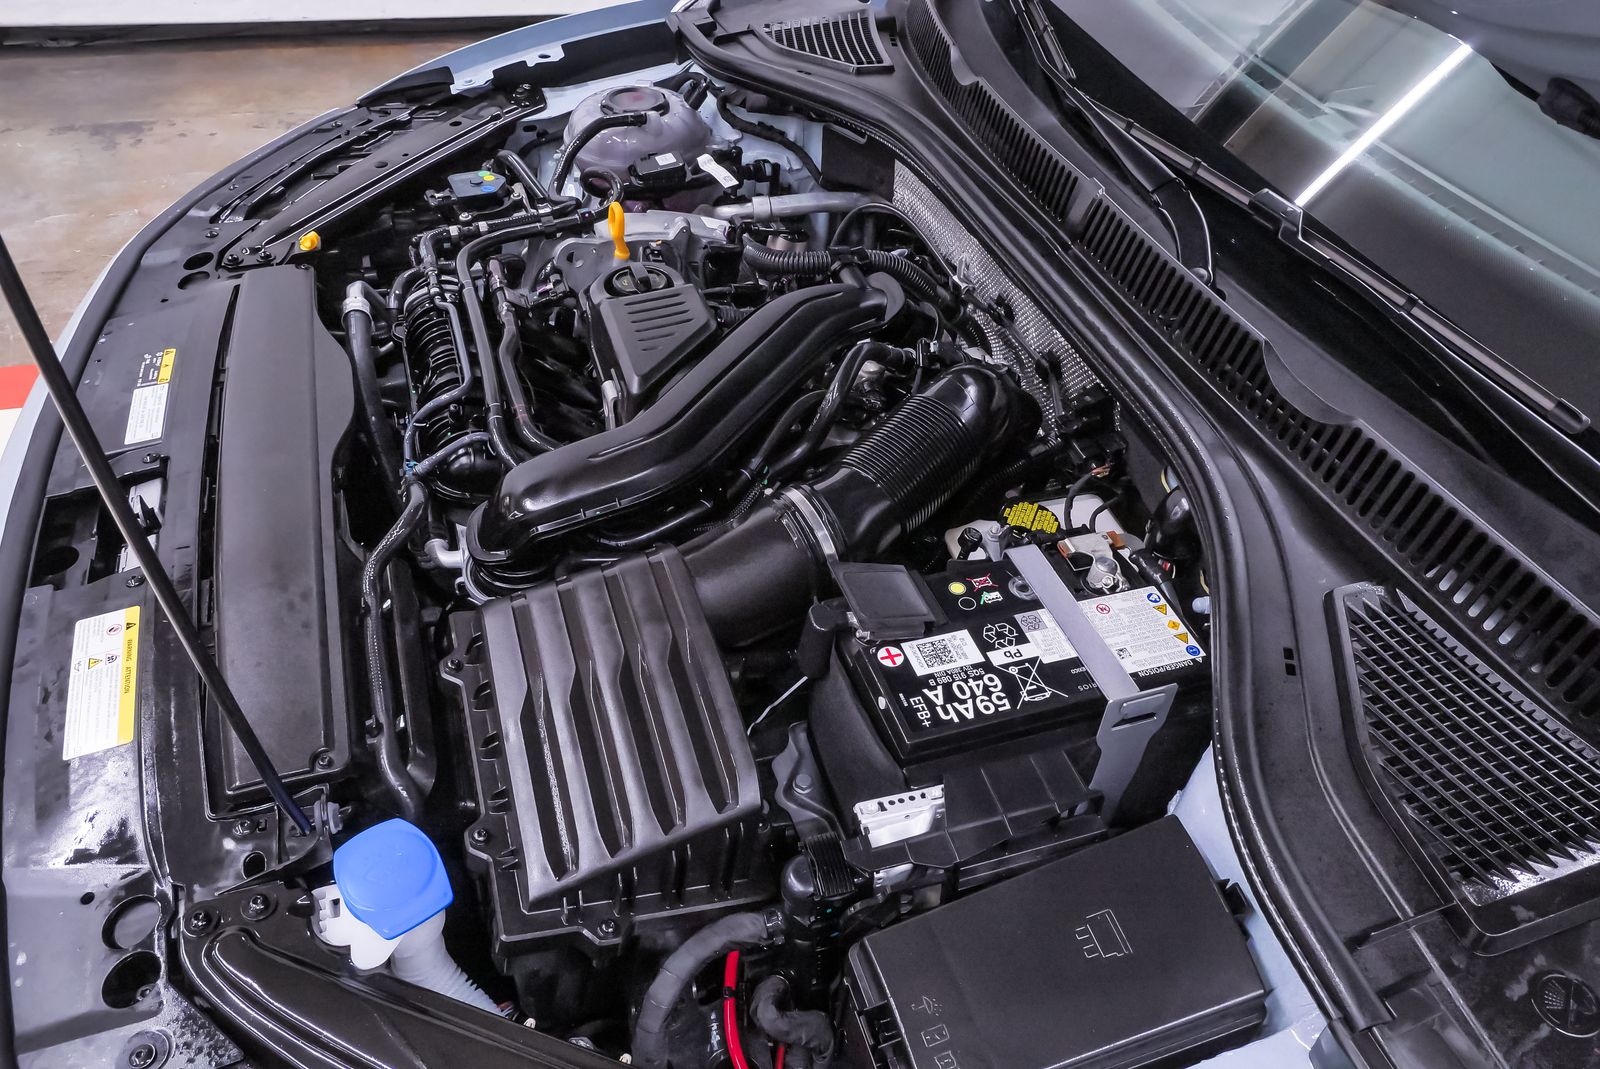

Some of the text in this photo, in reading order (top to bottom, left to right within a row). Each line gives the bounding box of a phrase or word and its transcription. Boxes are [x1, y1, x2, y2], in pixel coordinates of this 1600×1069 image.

[1003, 649, 1023, 660] Pb
[124, 639, 133, 694] WARNING ATTENTION
[954, 671, 967, 681] 915
[968, 667, 985, 678] 5QS
[1138, 659, 1194, 677] DANGER/POISON
[922, 685, 945, 706] A
[952, 674, 1002, 700] 640
[1078, 682, 1098, 691] RIOS
[909, 696, 932, 728] EFB+
[935, 692, 1011, 723] 59Ah
